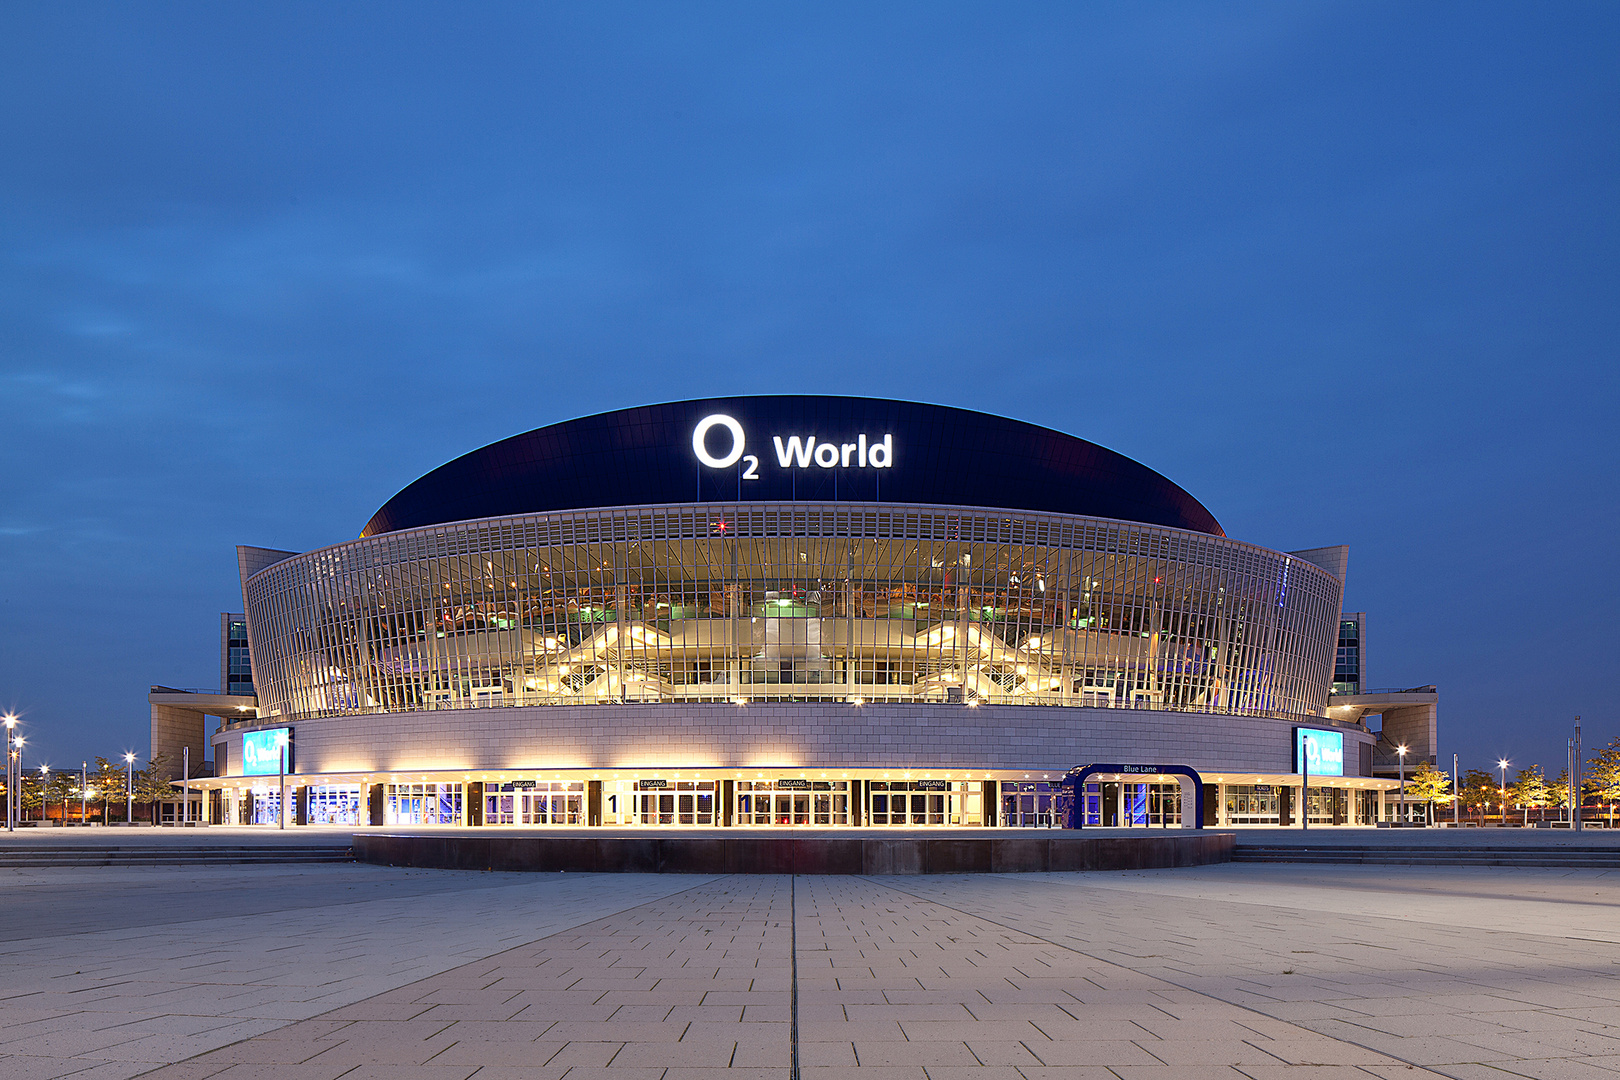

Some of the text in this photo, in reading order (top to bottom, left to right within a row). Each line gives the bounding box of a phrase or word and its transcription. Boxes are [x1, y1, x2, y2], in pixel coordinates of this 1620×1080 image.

[772, 433, 893, 469] World
[1123, 765, 1157, 773] Blue Lane
[919, 780, 945, 788] EINGANG
[608, 795, 616, 813] 1
[740, 795, 749, 813] 1
